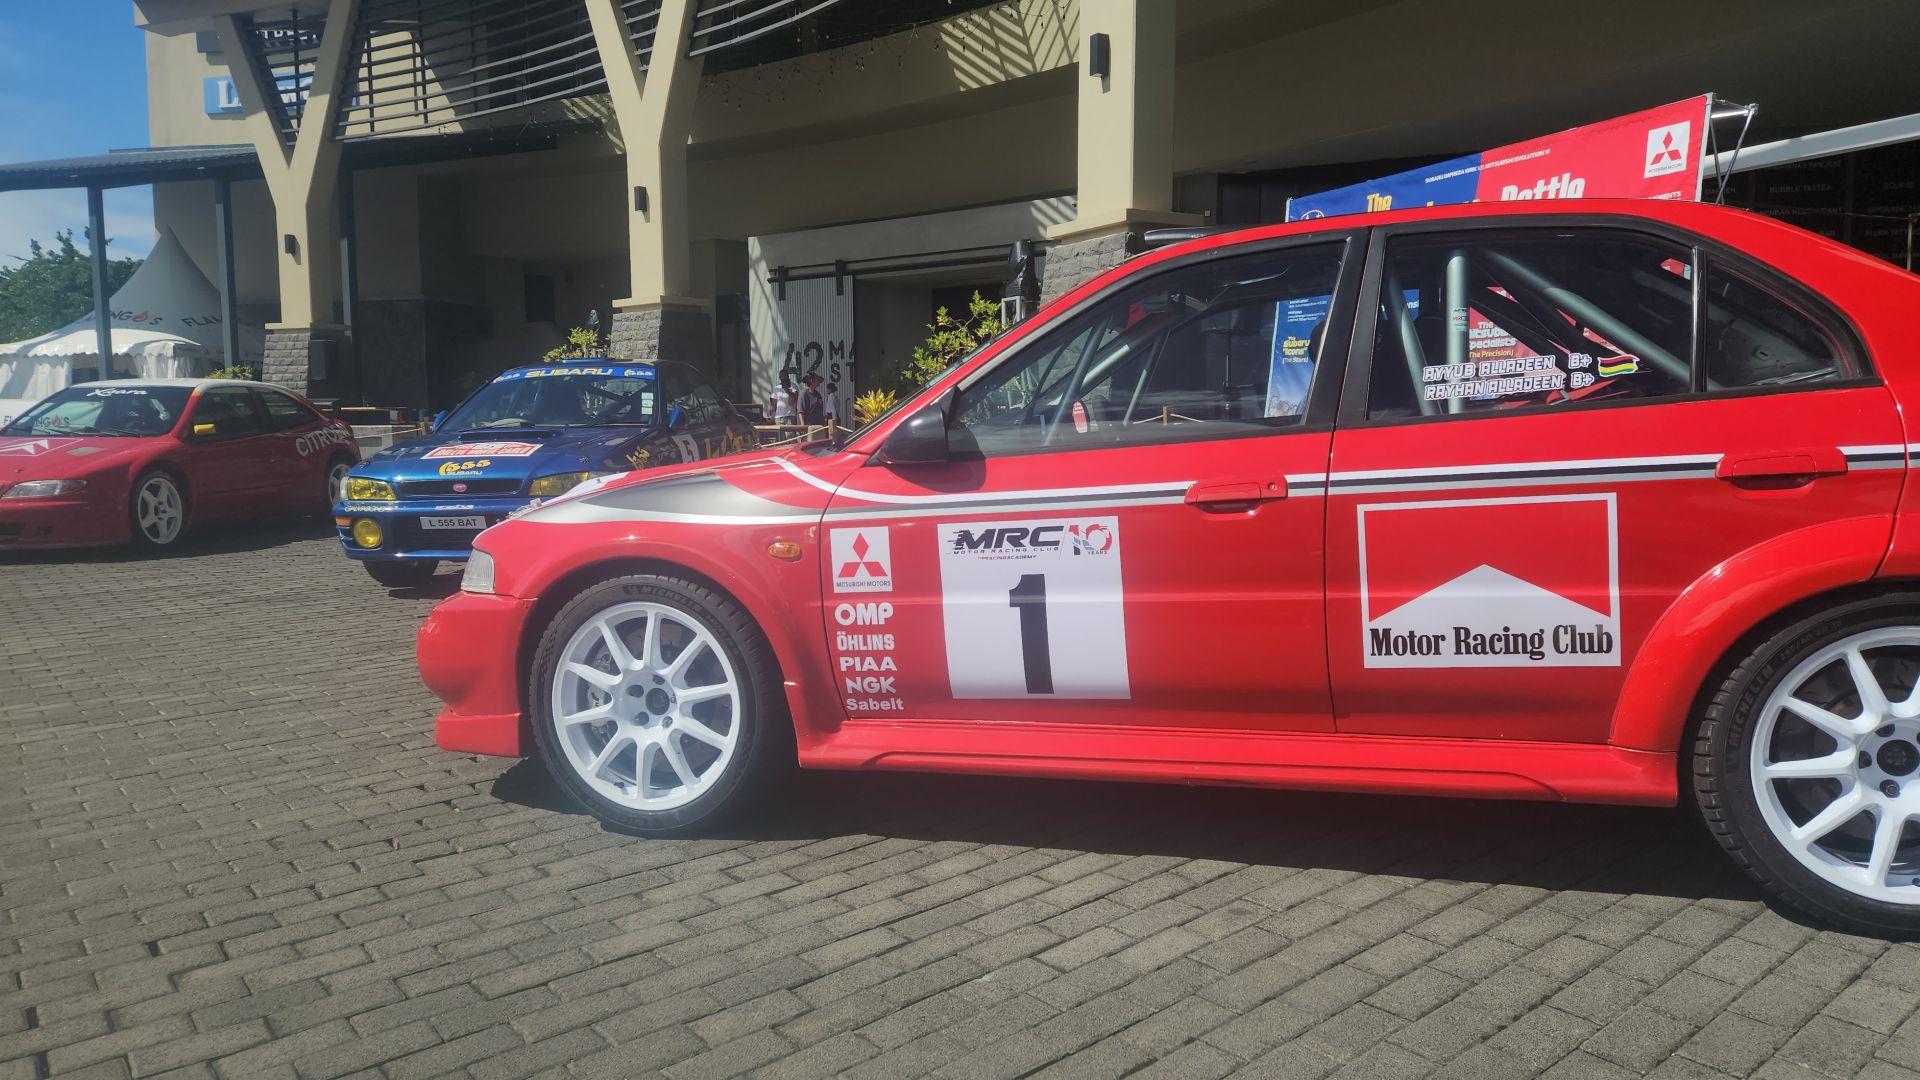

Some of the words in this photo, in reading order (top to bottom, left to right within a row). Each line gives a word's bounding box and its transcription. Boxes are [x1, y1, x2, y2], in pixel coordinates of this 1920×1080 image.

[1283, 339, 1310, 348] Subaru
[1470, 338, 1517, 350] pecialists
[524, 368, 613, 378] SUBARU
[782, 341, 824, 384] 42
[1424, 363, 1476, 382] AYYUB
[1568, 353, 1592, 369] B+
[1425, 380, 1487, 400] RAYHAN
[1570, 372, 1595, 389] B+
[428, 519, 436, 527] L
[437, 519, 455, 527] 555
[457, 518, 477, 527] BAT
[952, 525, 1065, 550] MRC
[640, 585, 703, 613] MICHELIN
[834, 602, 894, 625] OMP
[836, 631, 895, 651] ÖHLINS
[1009, 573, 1055, 694] 1
[1369, 628, 1446, 656] Motor
[1452, 626, 1545, 661] Racing
[1552, 624, 1613, 655] Club
[839, 656, 898, 672] PIAA
[845, 676, 896, 694] NGK
[846, 698, 904, 711] Sabelt
[1728, 664, 1775, 748] MICHELIN
